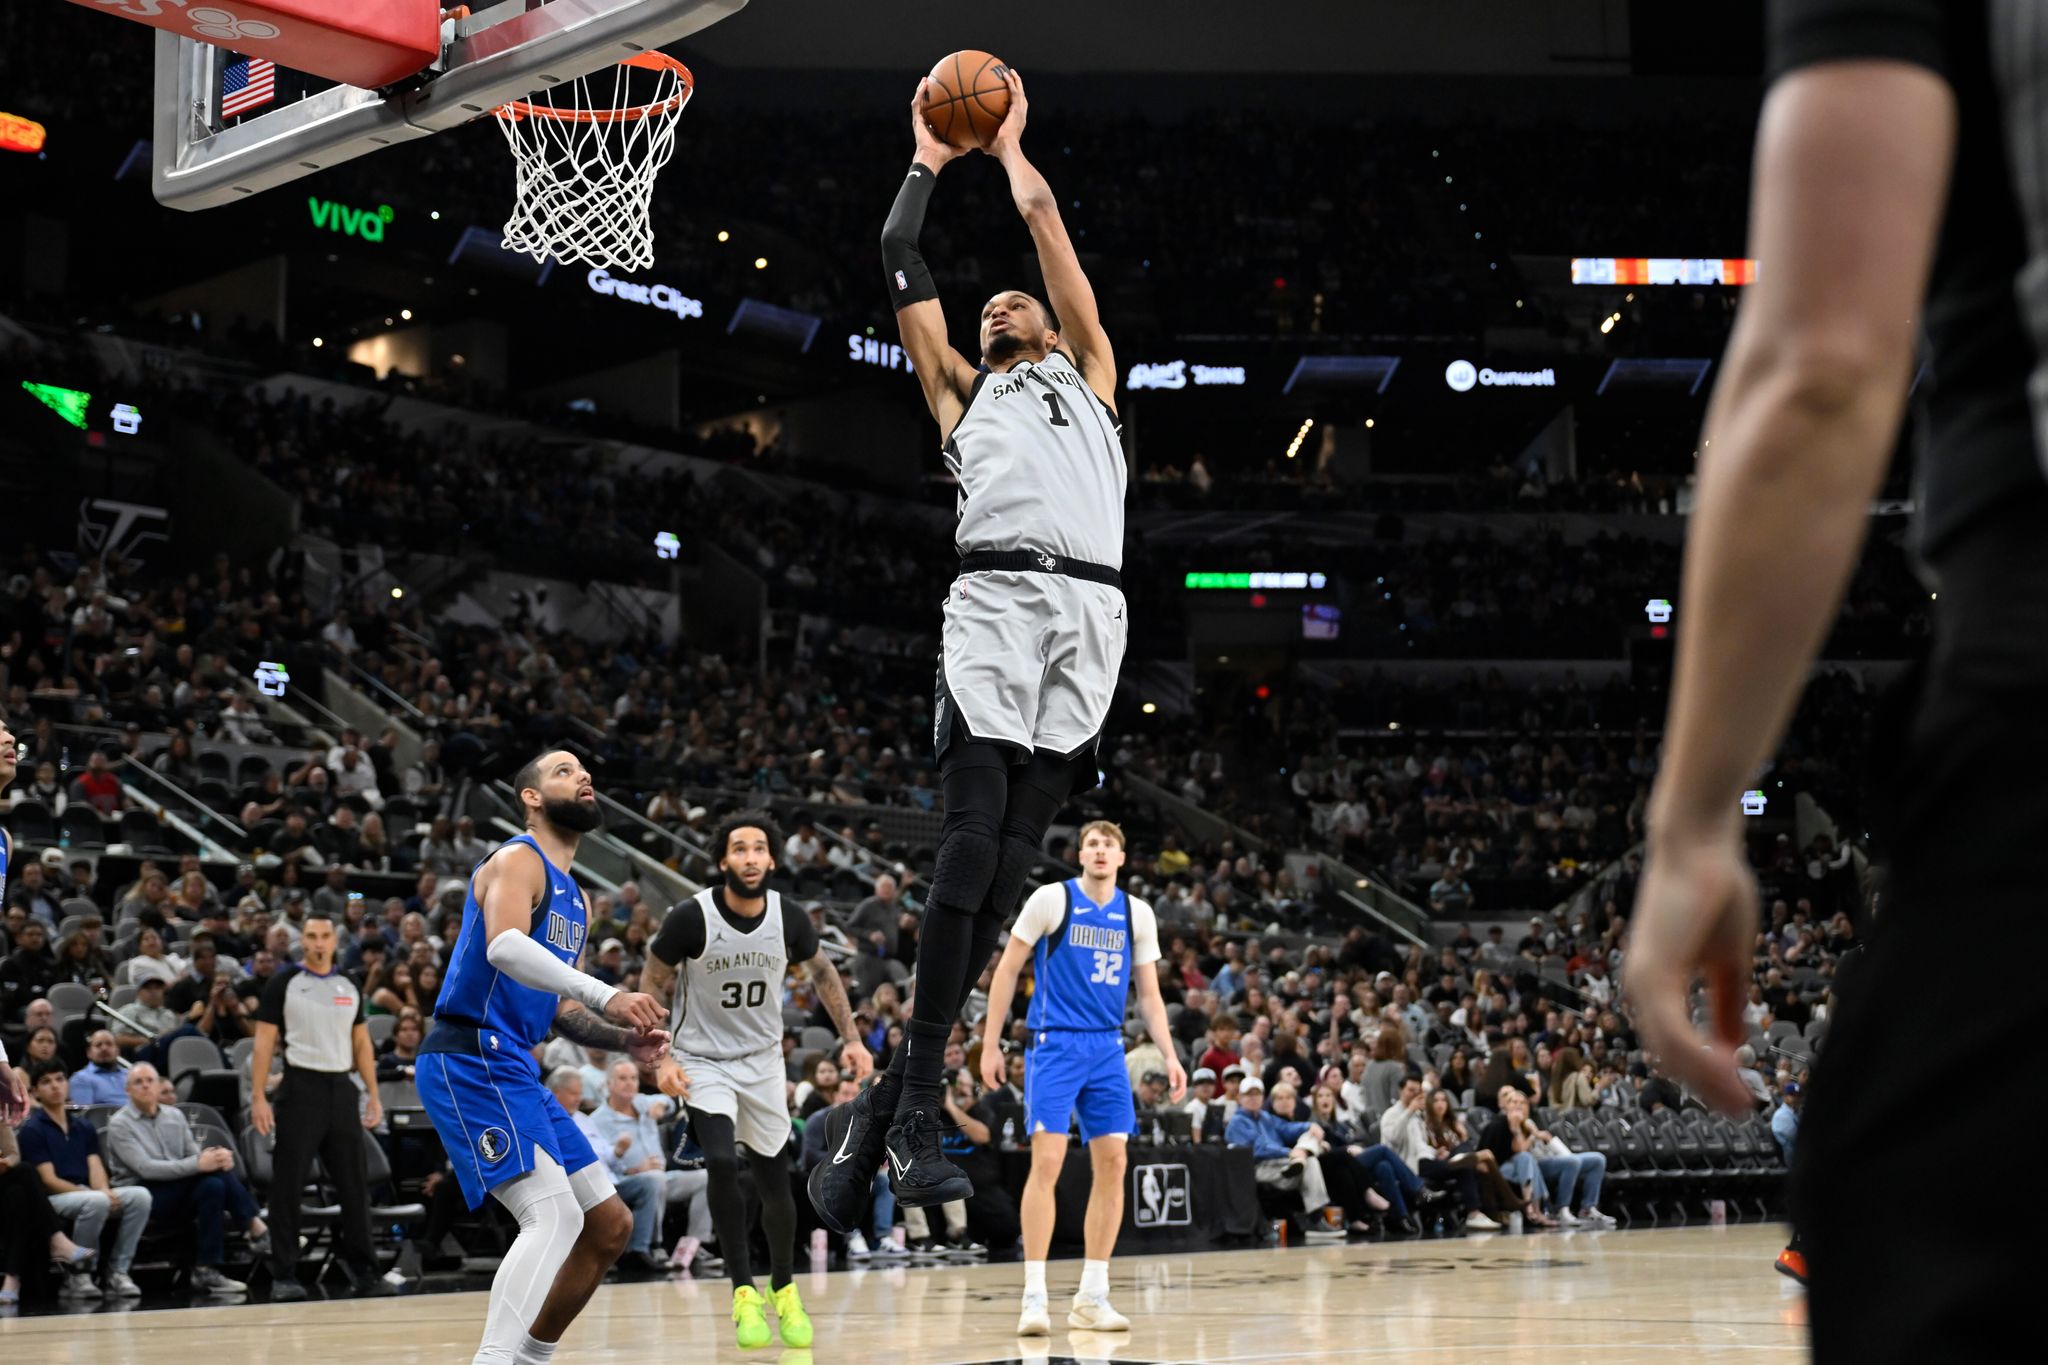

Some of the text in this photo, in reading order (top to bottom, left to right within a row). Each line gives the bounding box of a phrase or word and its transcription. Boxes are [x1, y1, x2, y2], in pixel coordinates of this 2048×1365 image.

[993, 373, 1025, 400] SAN
[1041, 392, 1070, 427] 1
[1069, 923, 1126, 952] DALLAS
[706, 951, 780, 975] SAN ANTONI
[1091, 950, 1123, 986] 32
[721, 979, 767, 1009] 30
